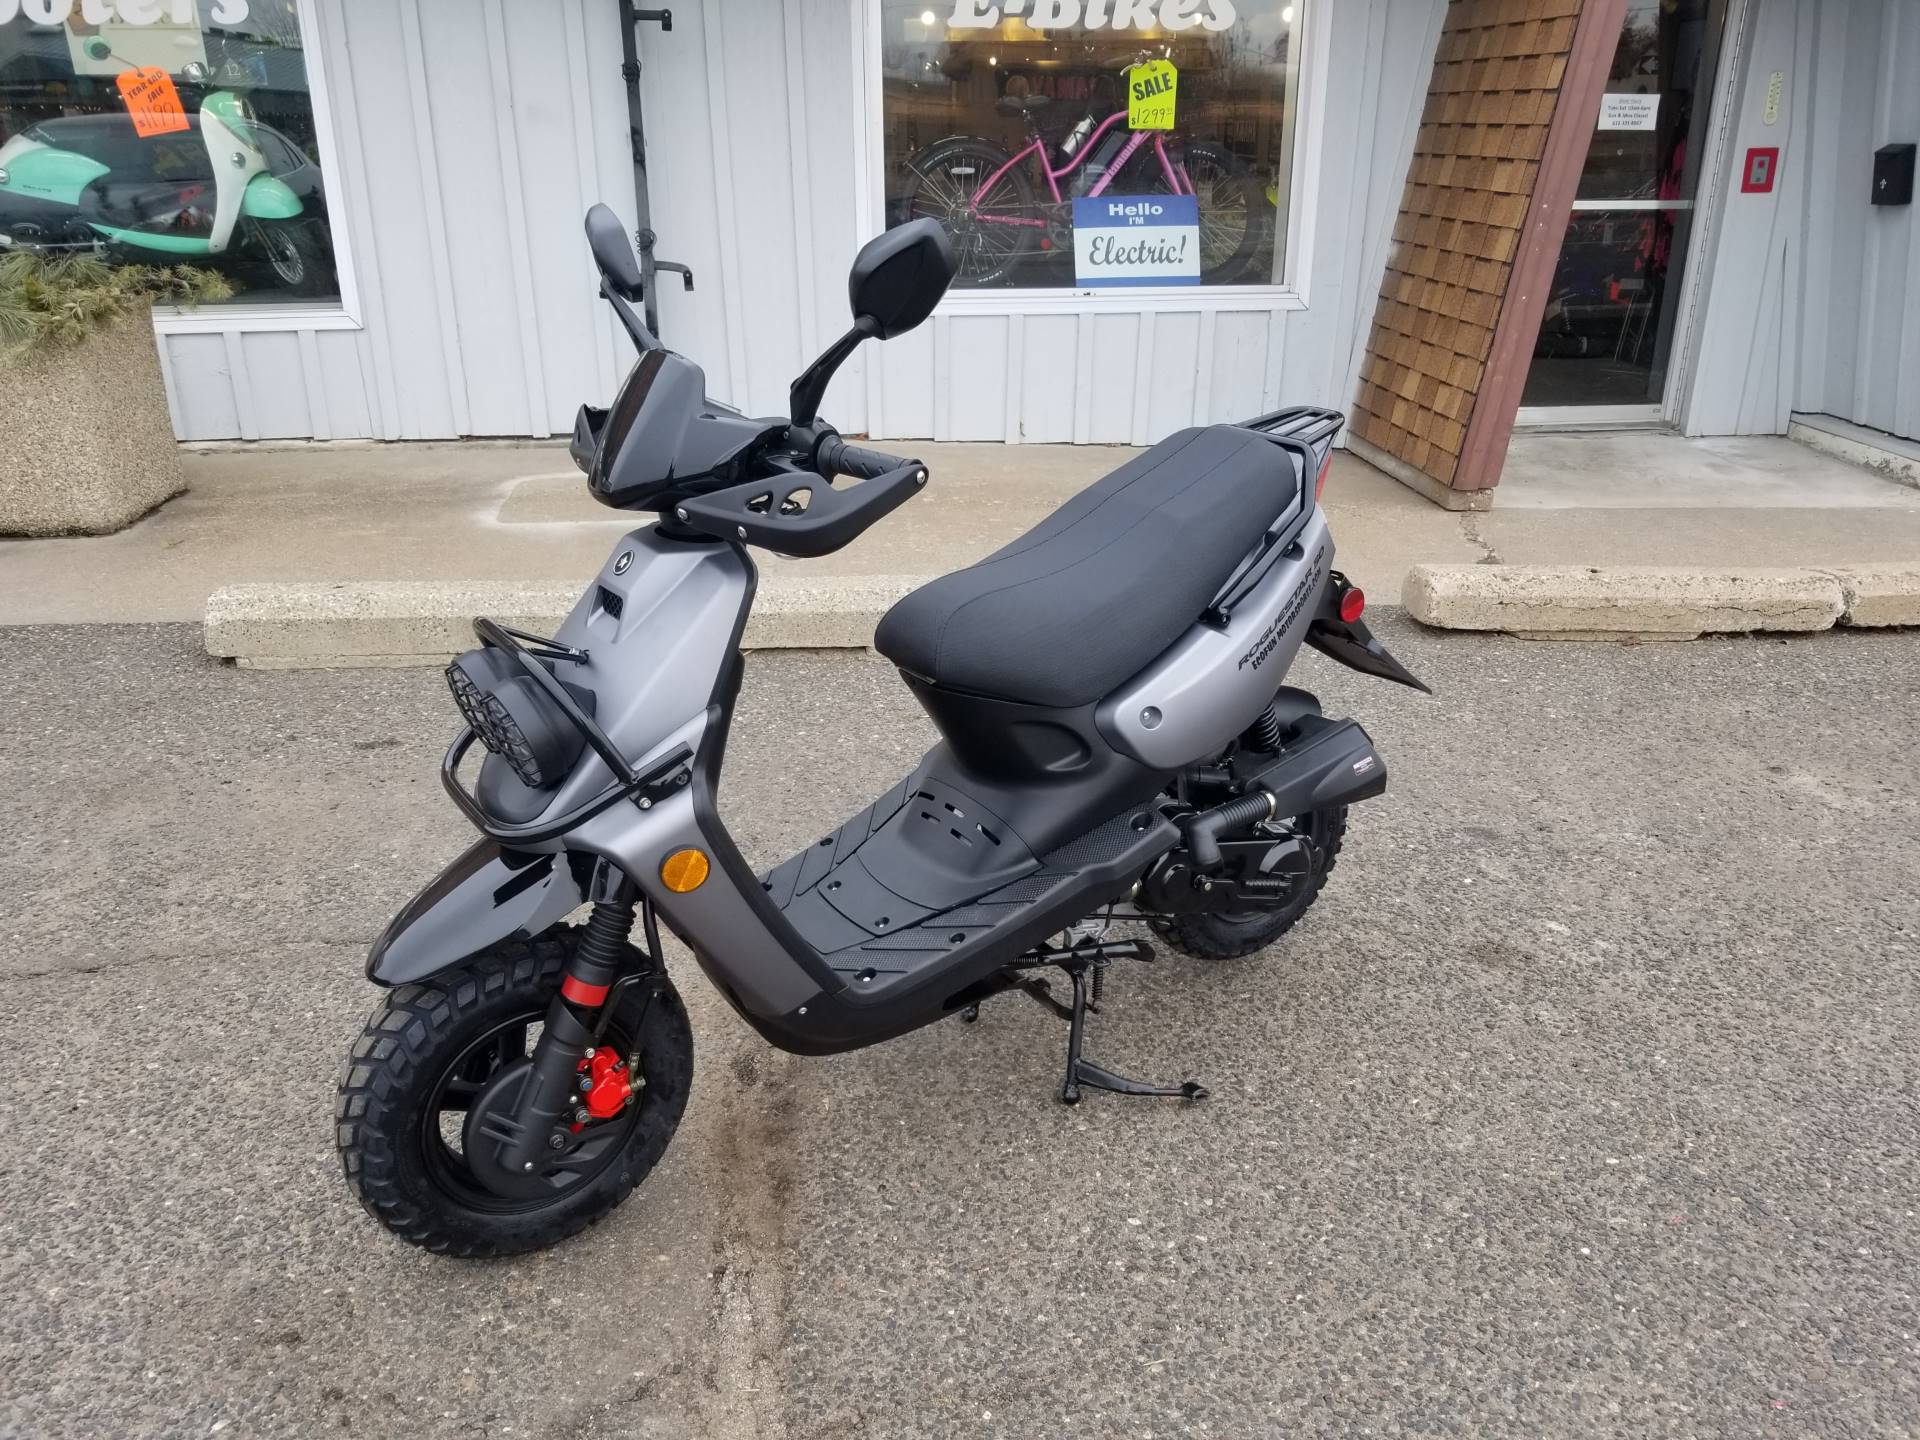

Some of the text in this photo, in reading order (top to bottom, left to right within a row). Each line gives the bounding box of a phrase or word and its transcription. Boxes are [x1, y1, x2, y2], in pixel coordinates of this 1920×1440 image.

[1133, 72, 1173, 101] SALE
[1109, 203, 1163, 216] Hello
[1129, 216, 1144, 225] I'M
[1089, 234, 1187, 266] Electric!
[1238, 567, 1312, 671] ROGUESTAR
[1251, 638, 1278, 671] ECOFUN
